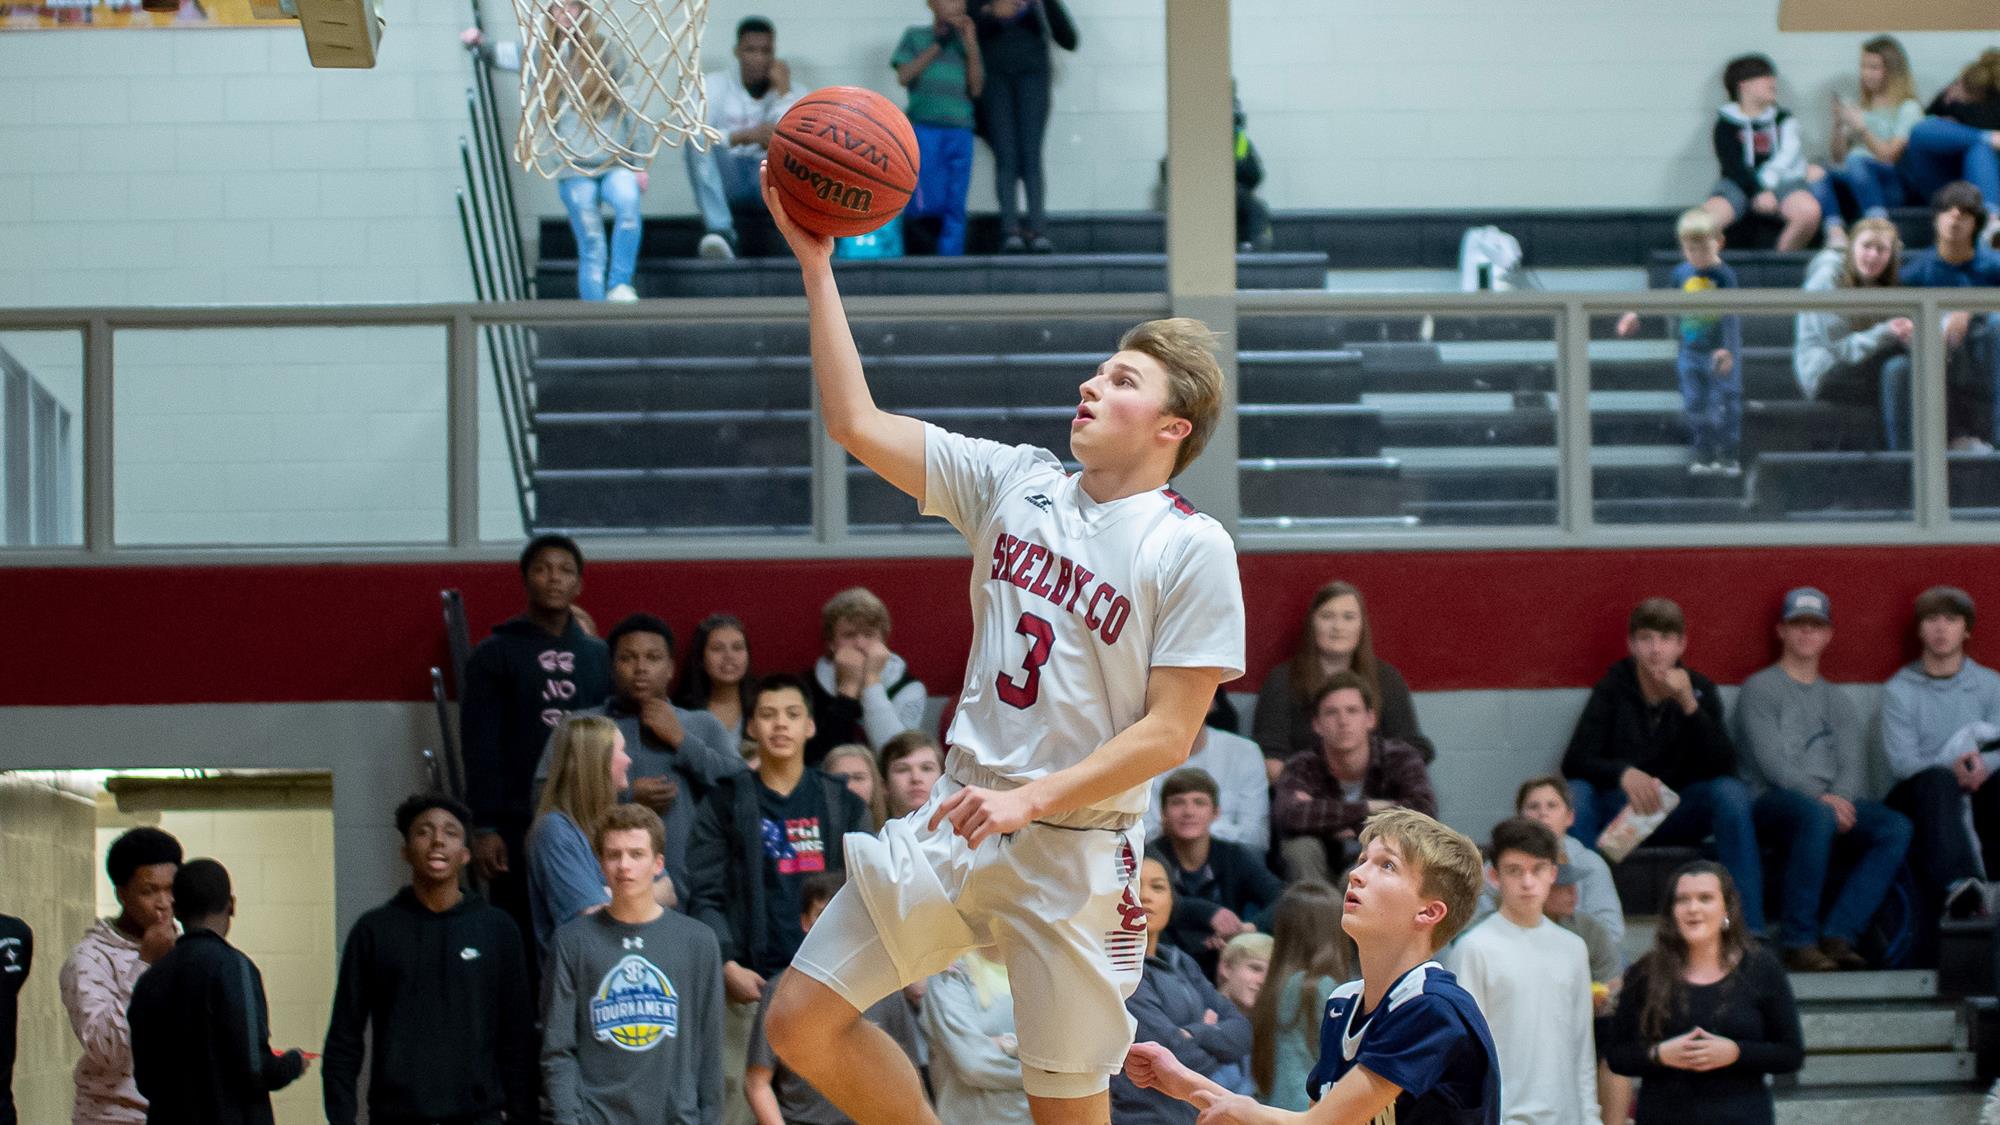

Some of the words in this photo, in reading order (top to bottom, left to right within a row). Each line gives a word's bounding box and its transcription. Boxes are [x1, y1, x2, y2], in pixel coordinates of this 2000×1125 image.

[796, 116, 890, 173] WAVE
[784, 151, 874, 213] Wilson
[991, 533, 1096, 614] SHELBY
[1084, 582, 1131, 646] CO
[995, 611, 1057, 710] 3
[594, 1000, 678, 1021] TOURNAMENT
